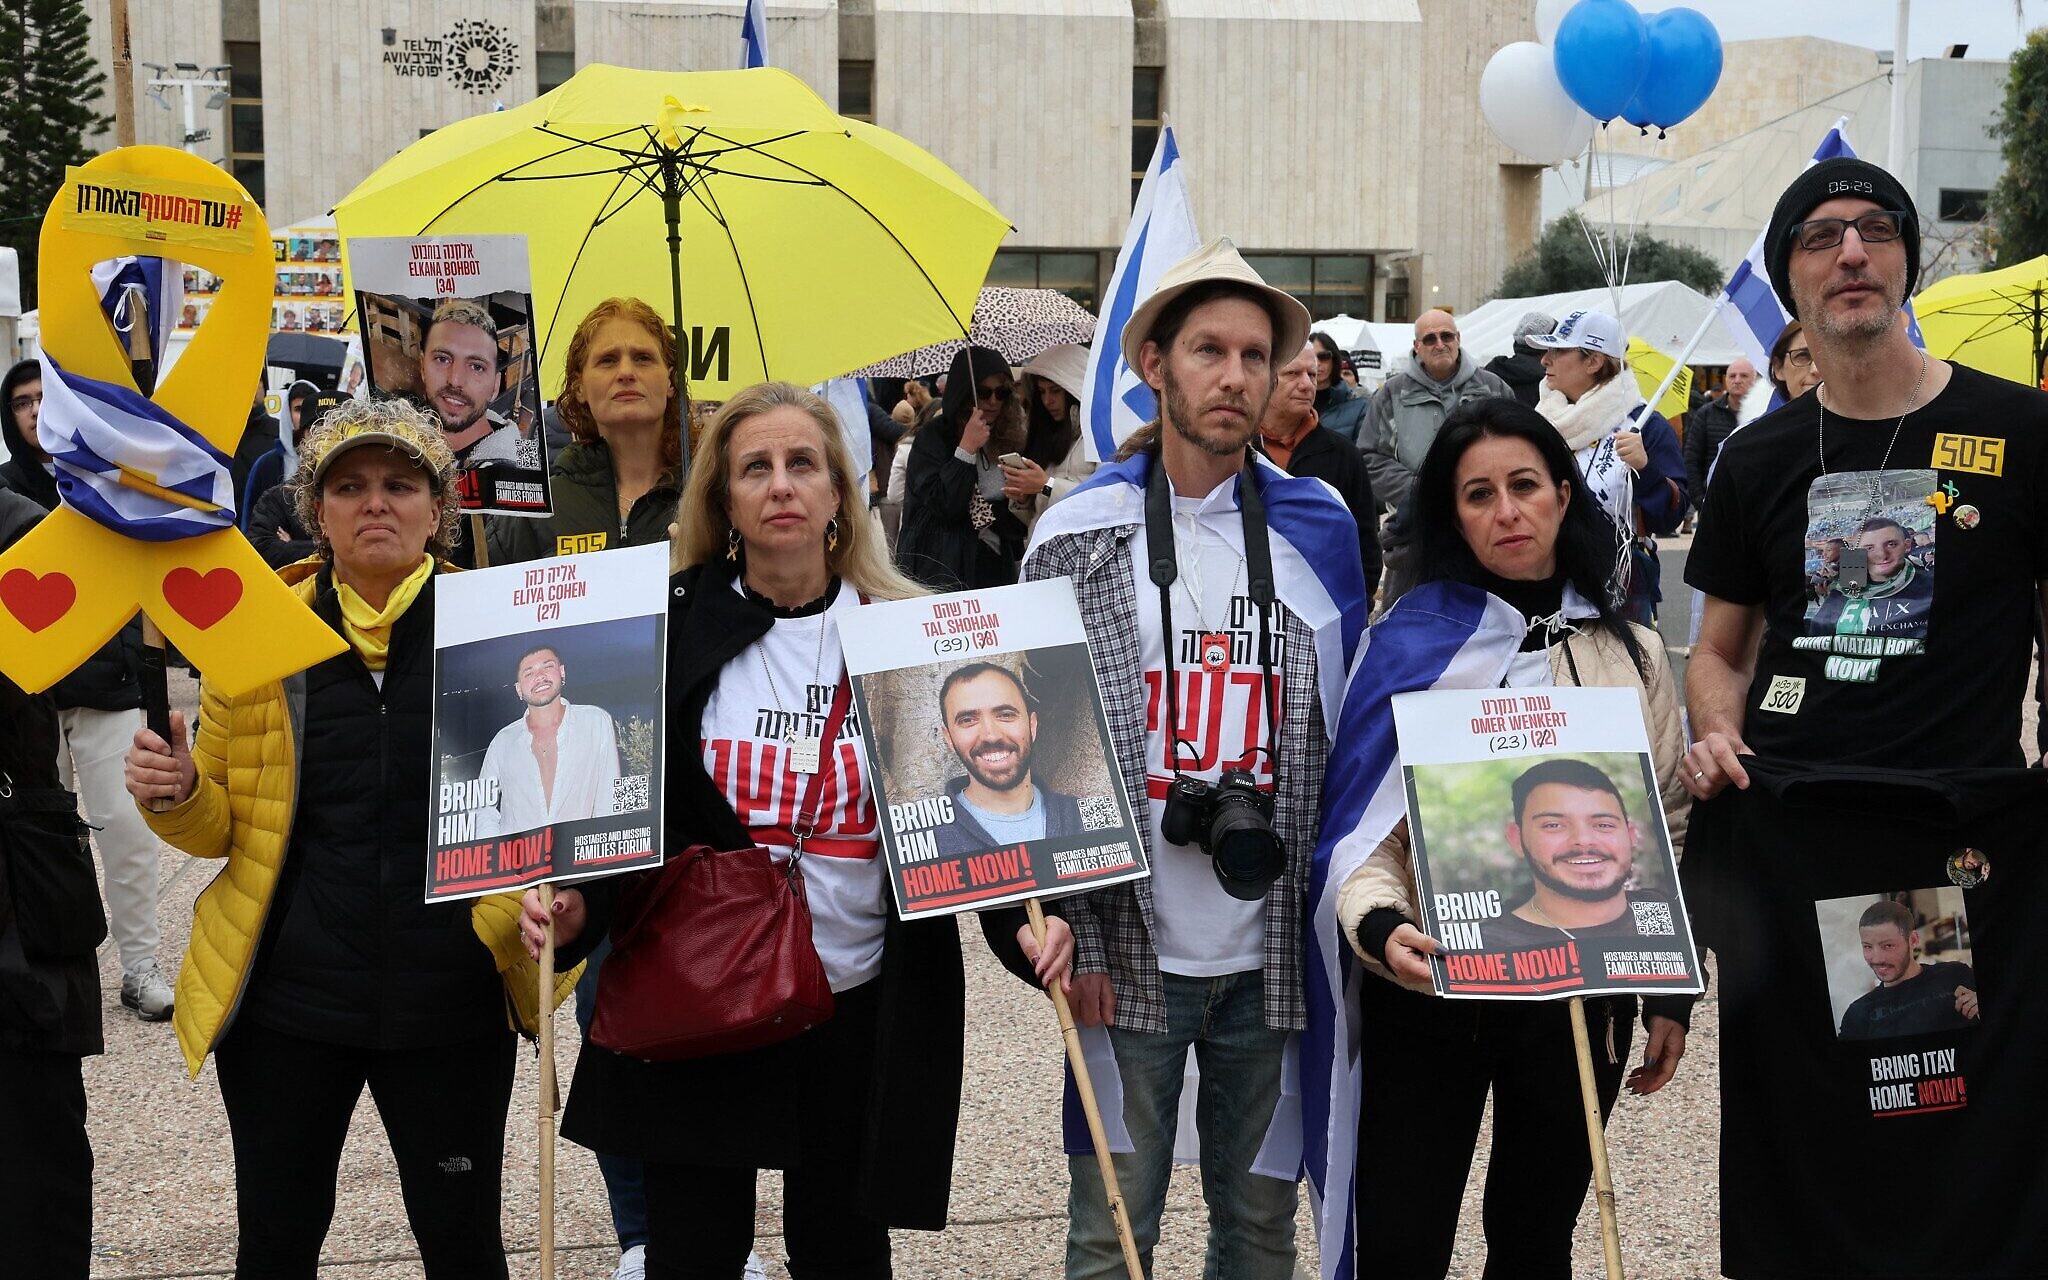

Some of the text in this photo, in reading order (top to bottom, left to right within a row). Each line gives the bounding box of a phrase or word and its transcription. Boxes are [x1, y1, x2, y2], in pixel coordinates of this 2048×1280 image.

[403, 40, 425, 51] TEL
[424, 37, 442, 52] תל
[383, 52, 411, 63] AVIV
[411, 52, 442, 64] אביב
[394, 65, 425, 76] YAFO
[425, 66, 443, 77] יפו
[1828, 180, 1873, 194] 06:29
[411, 242, 474, 260] אלקנה בוחבוט
[408, 260, 480, 277] ELKANA BOHBOT
[436, 277, 456, 295] (34)
[1941, 436, 1999, 473] SOS
[495, 480, 543, 492] HOSTAGES AND MISSING
[496, 489, 544, 504] FAMILIES FORUM
[560, 534, 602, 556] SOS
[525, 564, 576, 588] אליה כהן
[513, 581, 586, 606] ELIYA COHEN
[537, 601, 560, 622] (27)
[933, 599, 981, 619] טל שהם
[922, 613, 1000, 637] TAL SHOHAM
[934, 636, 970, 656] (39)
[1833, 635, 1884, 656] MATAN
[1825, 655, 1882, 682] NOW!
[1481, 696, 1551, 716] עומר ונקרט
[1471, 712, 1567, 734] OMER WENKERT
[1489, 733, 1527, 753] (23)
[1235, 778, 1253, 787] Nikon
[439, 777, 499, 814] BRING
[888, 795, 955, 834] BRING
[438, 811, 477, 846] HIM
[574, 827, 651, 847] HOSTAGES AND MISSING
[436, 827, 553, 881] HOME NOW!
[574, 837, 651, 861] FAMILIES FORUM
[895, 829, 939, 865] HIM
[1052, 841, 1130, 862] HOSTAGES AND MISSING
[901, 844, 1033, 898] HOME NOW!
[1055, 850, 1134, 875] FAMILIES FORUM
[1433, 889, 1502, 921] BRING
[1439, 922, 1484, 950] HIM
[1445, 941, 1581, 981] HOME NOW!
[1603, 951, 1684, 962] HOSTAGES AND MISSING
[1605, 961, 1686, 976] FAMILIES FORUM
[1870, 1048, 1955, 1081] BRING ITAY
[1869, 1076, 1967, 1111] HOME NOW!
